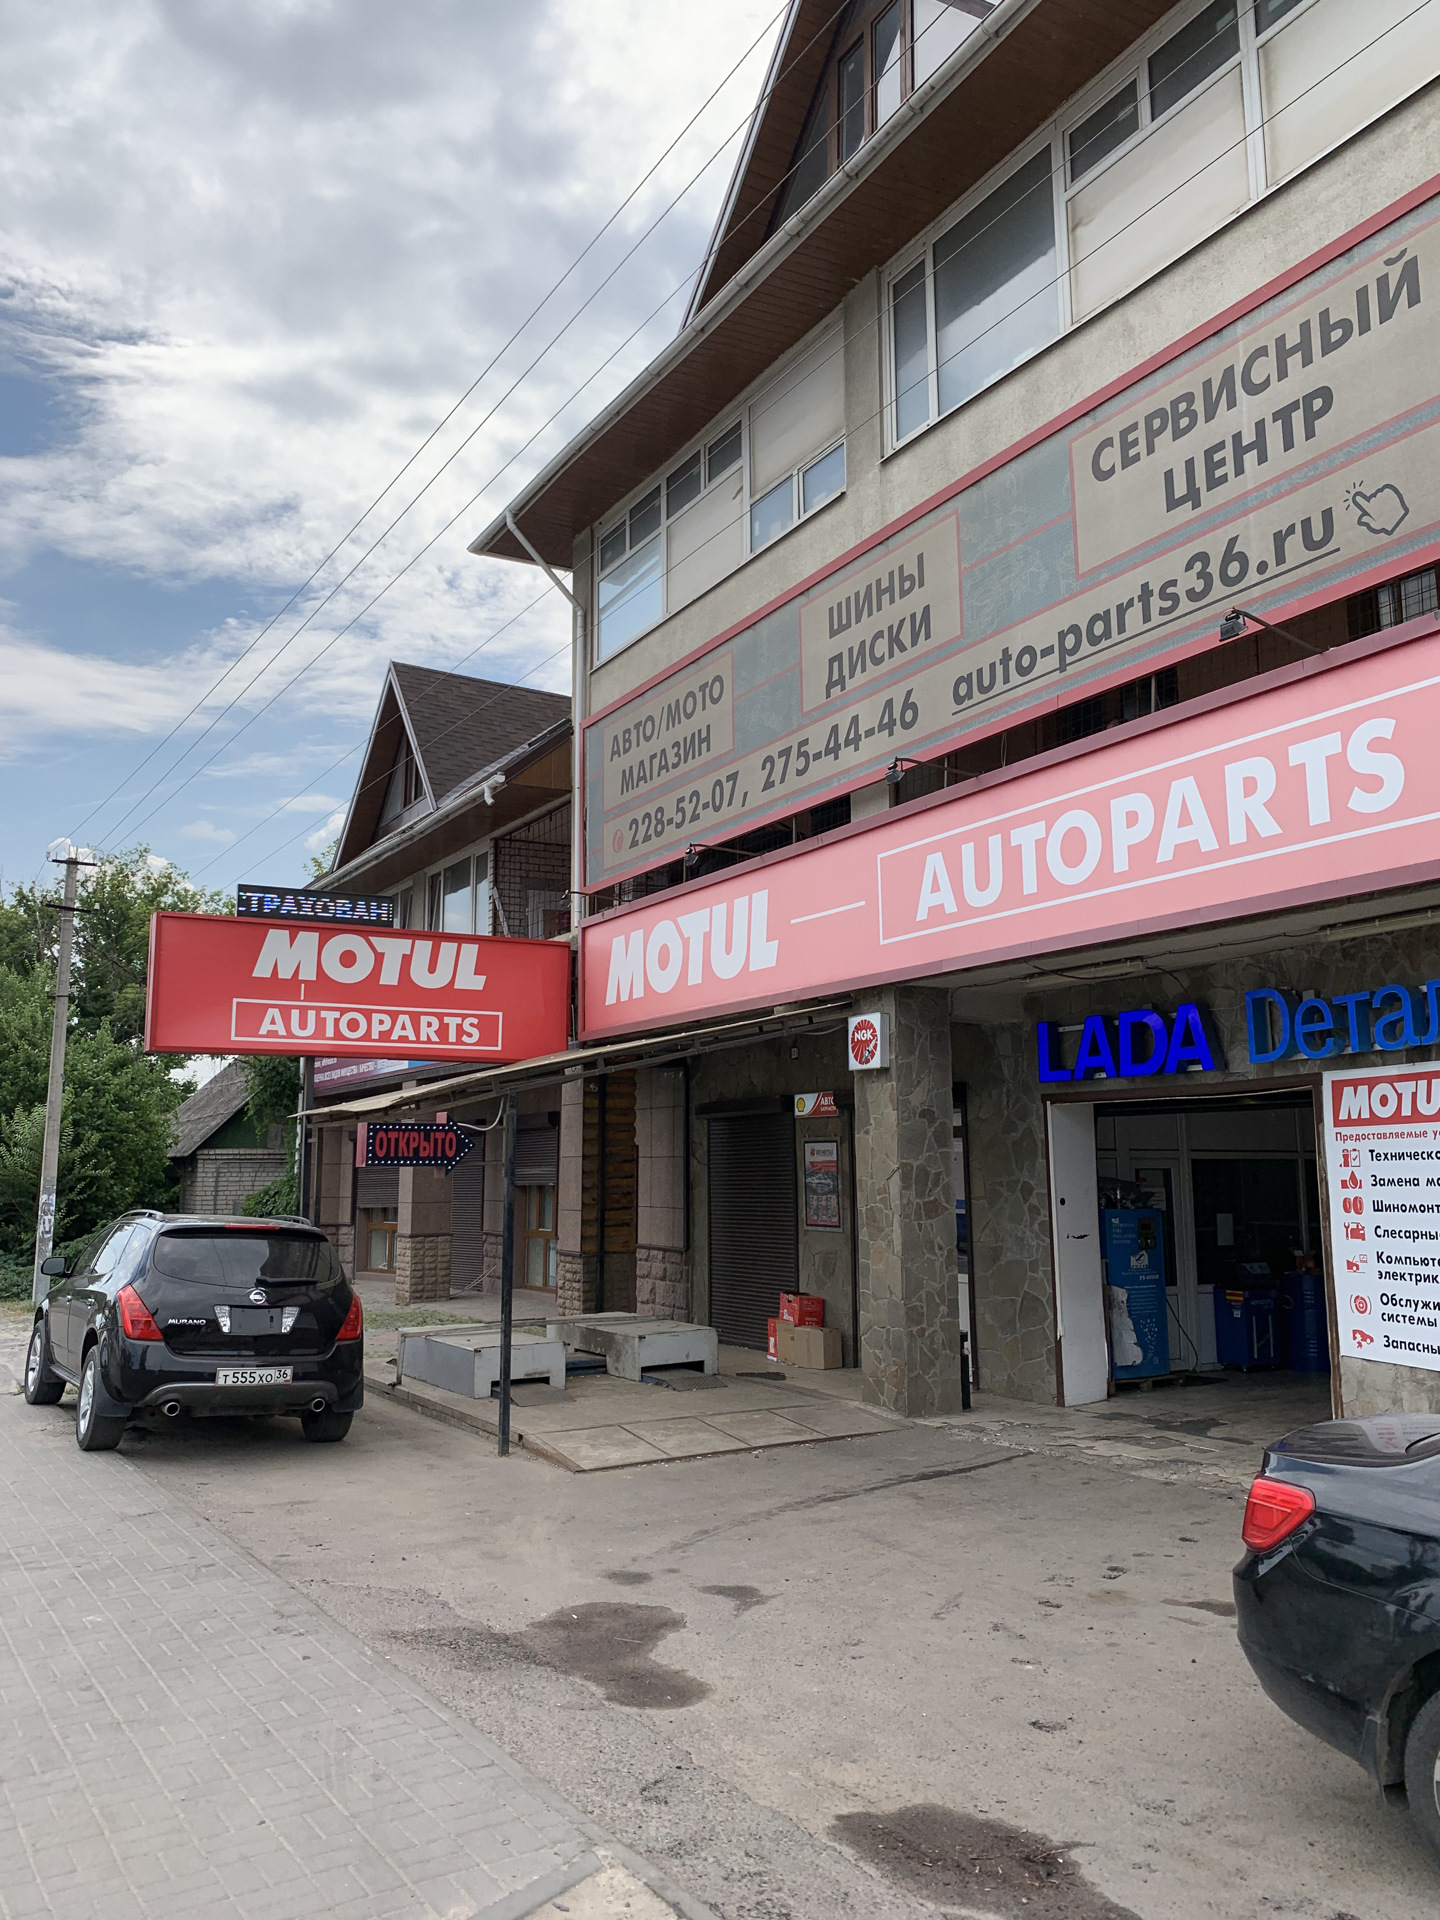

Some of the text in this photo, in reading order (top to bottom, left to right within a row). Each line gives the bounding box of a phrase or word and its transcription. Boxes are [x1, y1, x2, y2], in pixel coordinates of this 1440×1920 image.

[1091, 247, 1422, 482] СЕРВИСНЫЙ
[1163, 385, 1334, 513] ЦЕНТР
[827, 552, 926, 640] ШИНЫ
[825, 604, 932, 700] ДИСКИ
[628, 506, 1335, 850] 228-52-07, 275-44-46 auto-parts36.ru
[609, 673, 725, 763] АВТО/МОТО
[620, 724, 712, 796] МАГАЗИН
[605, 717, 1406, 1006] MOTUL AUTOPARTS
[238, 891, 393, 921] ТРАХОВАН
[252, 928, 487, 991] MOTUL
[258, 1007, 481, 1044] AUTOPARTS
[854, 1028, 874, 1042] NGK
[1037, 1002, 1216, 1083] LADA
[375, 1130, 457, 1158] ОТКРЫТО
[1335, 1130, 1428, 1144] Предоставляемые
[1370, 1174, 1420, 1188] Замена
[1374, 1225, 1440, 1243] Слесарны
[1377, 1270, 1440, 1286] электрик
[1380, 1292, 1440, 1313] Обслужи
[1381, 1312, 1438, 1328] системы
[168, 1318, 206, 1326] MURANO
